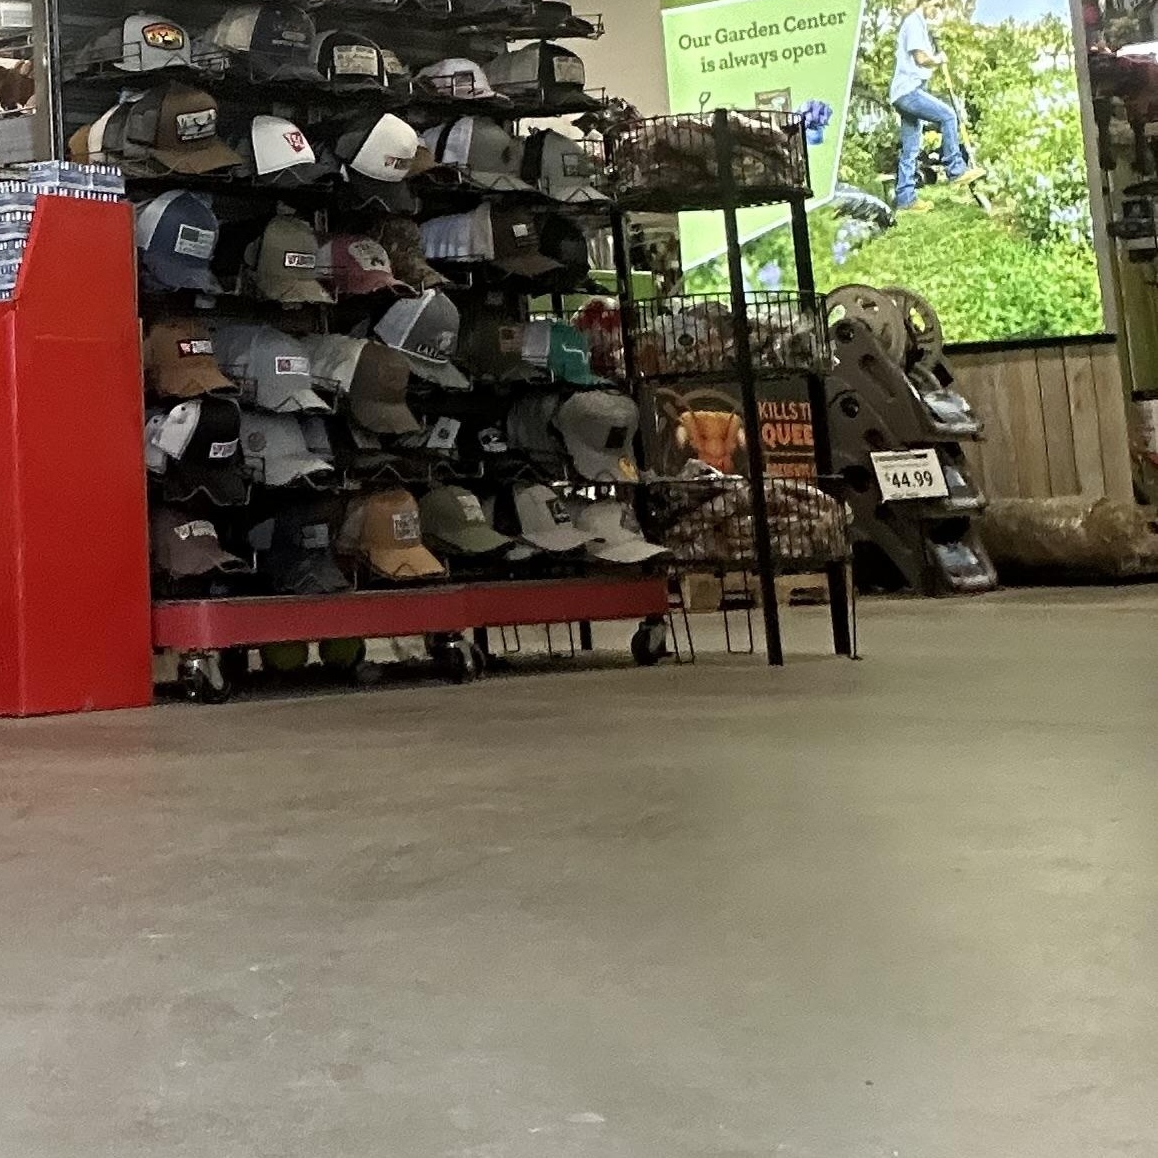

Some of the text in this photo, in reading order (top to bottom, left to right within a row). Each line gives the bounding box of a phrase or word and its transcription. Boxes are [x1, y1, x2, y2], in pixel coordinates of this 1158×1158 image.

[678, 10, 848, 51] Our Garden Center
[700, 41, 828, 73] is always open
[757, 401, 799, 421] KILLS
[761, 422, 815, 449] QUEE
